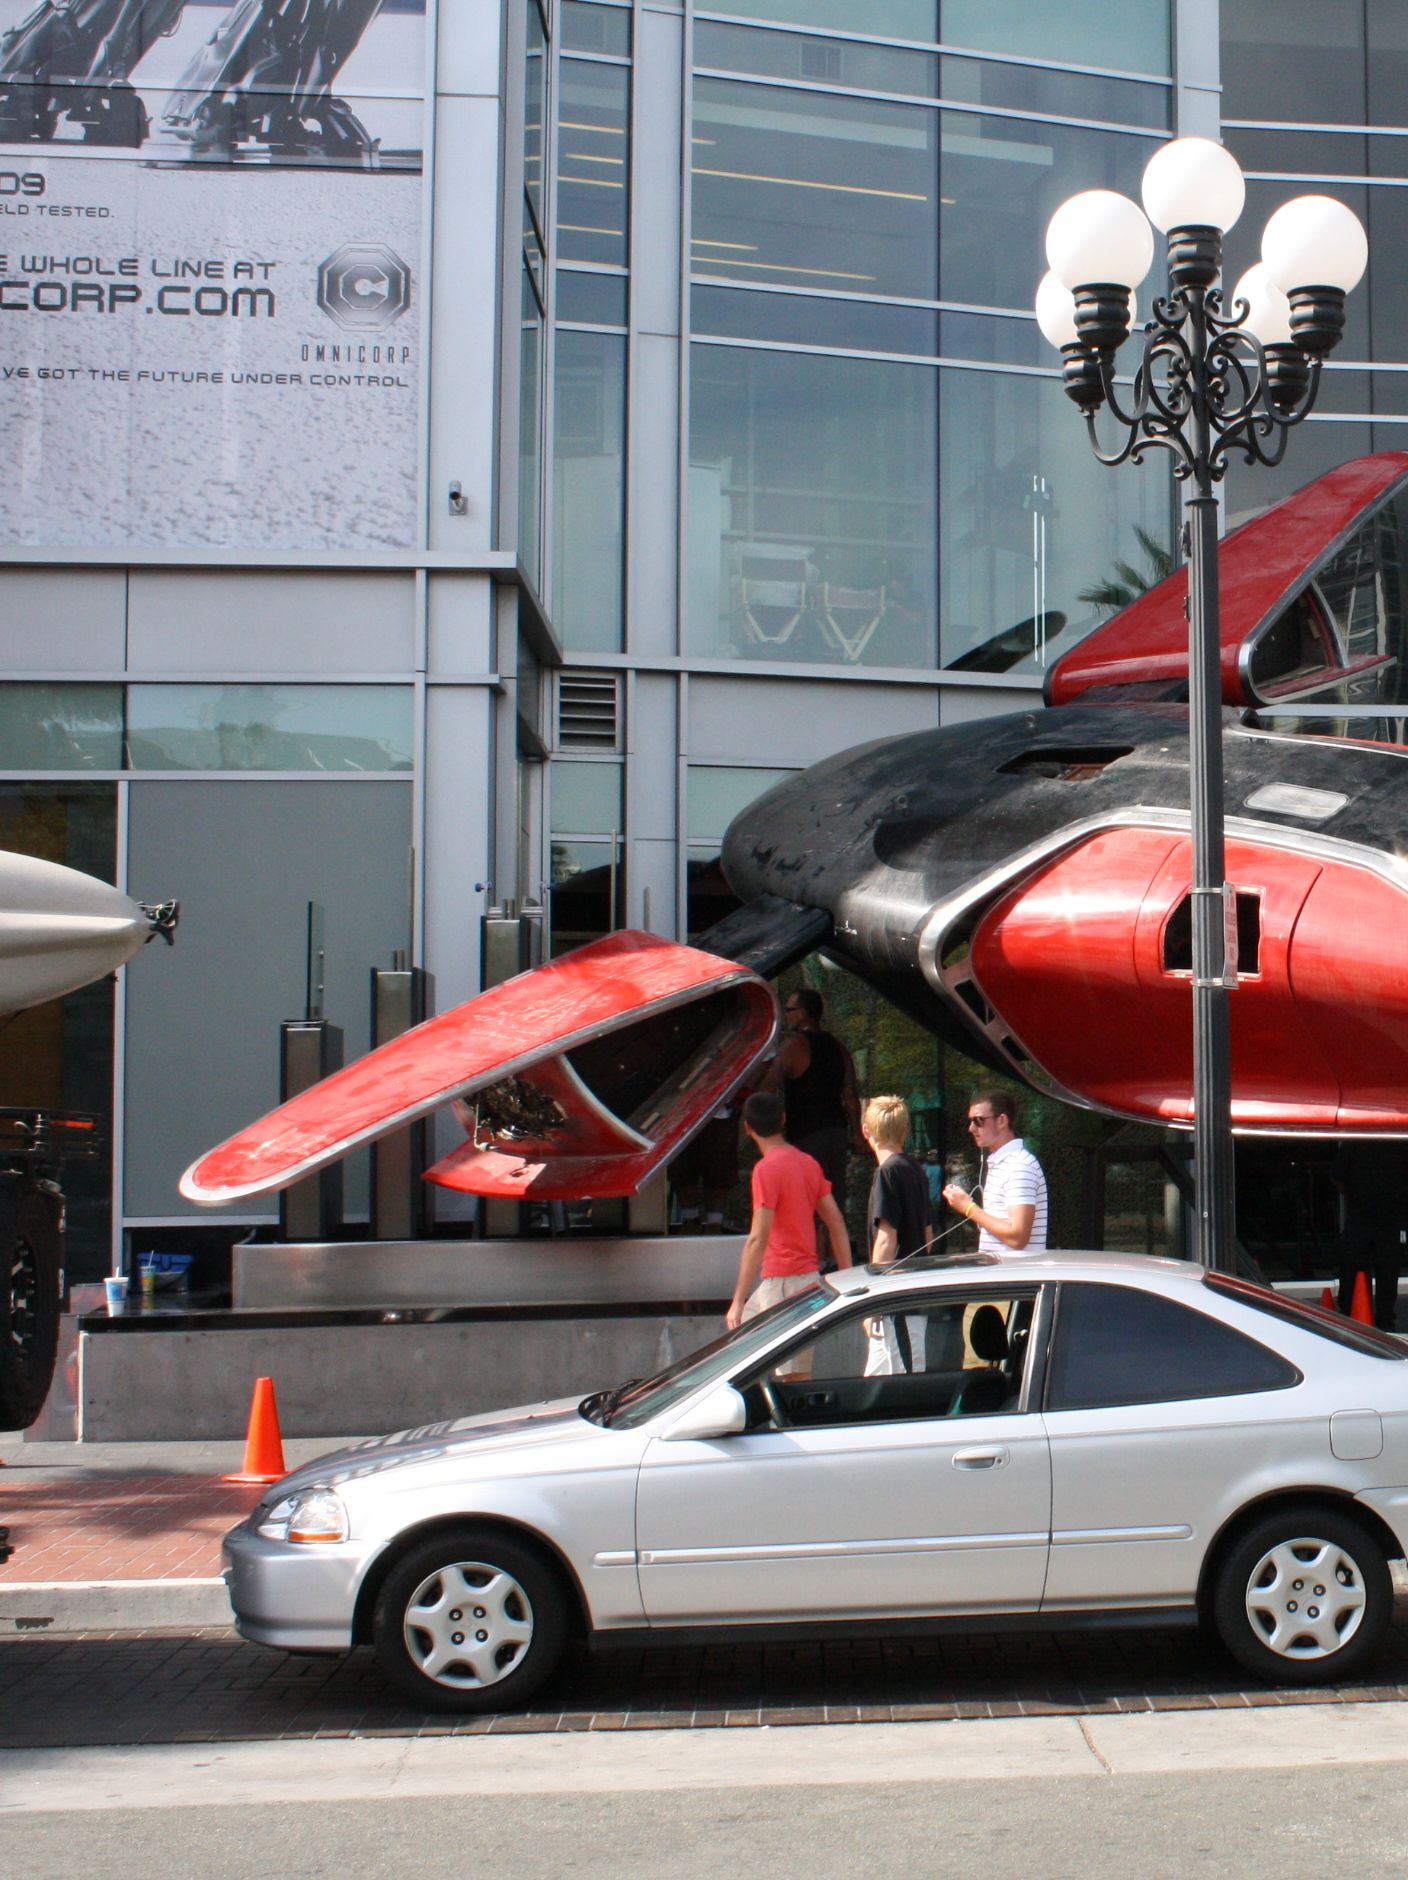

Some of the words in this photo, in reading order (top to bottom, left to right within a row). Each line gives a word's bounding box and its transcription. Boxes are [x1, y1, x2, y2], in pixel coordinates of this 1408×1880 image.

[0, 204, 29, 216] LD
[37, 205, 115, 218] TESTED.
[21, 255, 139, 276] WHOLE
[151, 259, 225, 279] LINE
[233, 262, 276, 280] AT
[301, 344, 410, 364] OMNICORP
[37, 368, 81, 379] GOT
[88, 369, 131, 381] THE
[137, 371, 224, 383] FUTURE
[231, 373, 303, 385] UNDER
[309, 374, 409, 388] CONTROL
